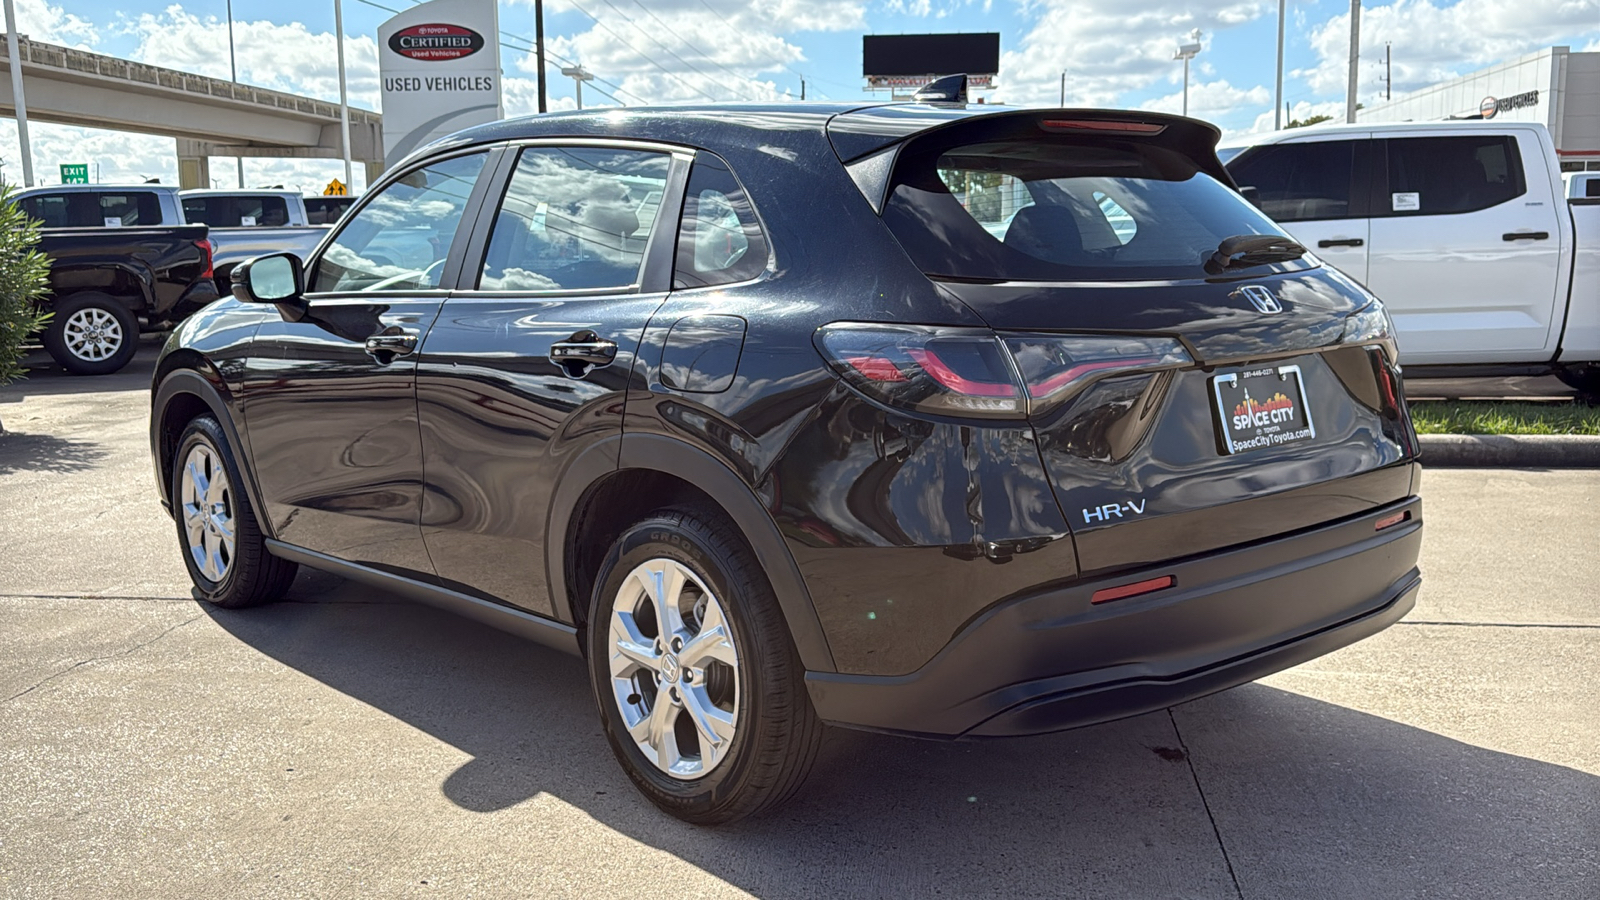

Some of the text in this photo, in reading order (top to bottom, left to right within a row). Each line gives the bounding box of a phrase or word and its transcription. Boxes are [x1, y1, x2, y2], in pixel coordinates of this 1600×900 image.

[400, 36, 471, 48] CERTIFIED
[384, 77, 492, 92] USED VEHICLES
[63, 167, 85, 175] EXIT
[1233, 407, 1294, 430] SPACE CITY
[1233, 428, 1311, 452] SpaceCityToyota.com
[1082, 498, 1146, 524] HR-V
